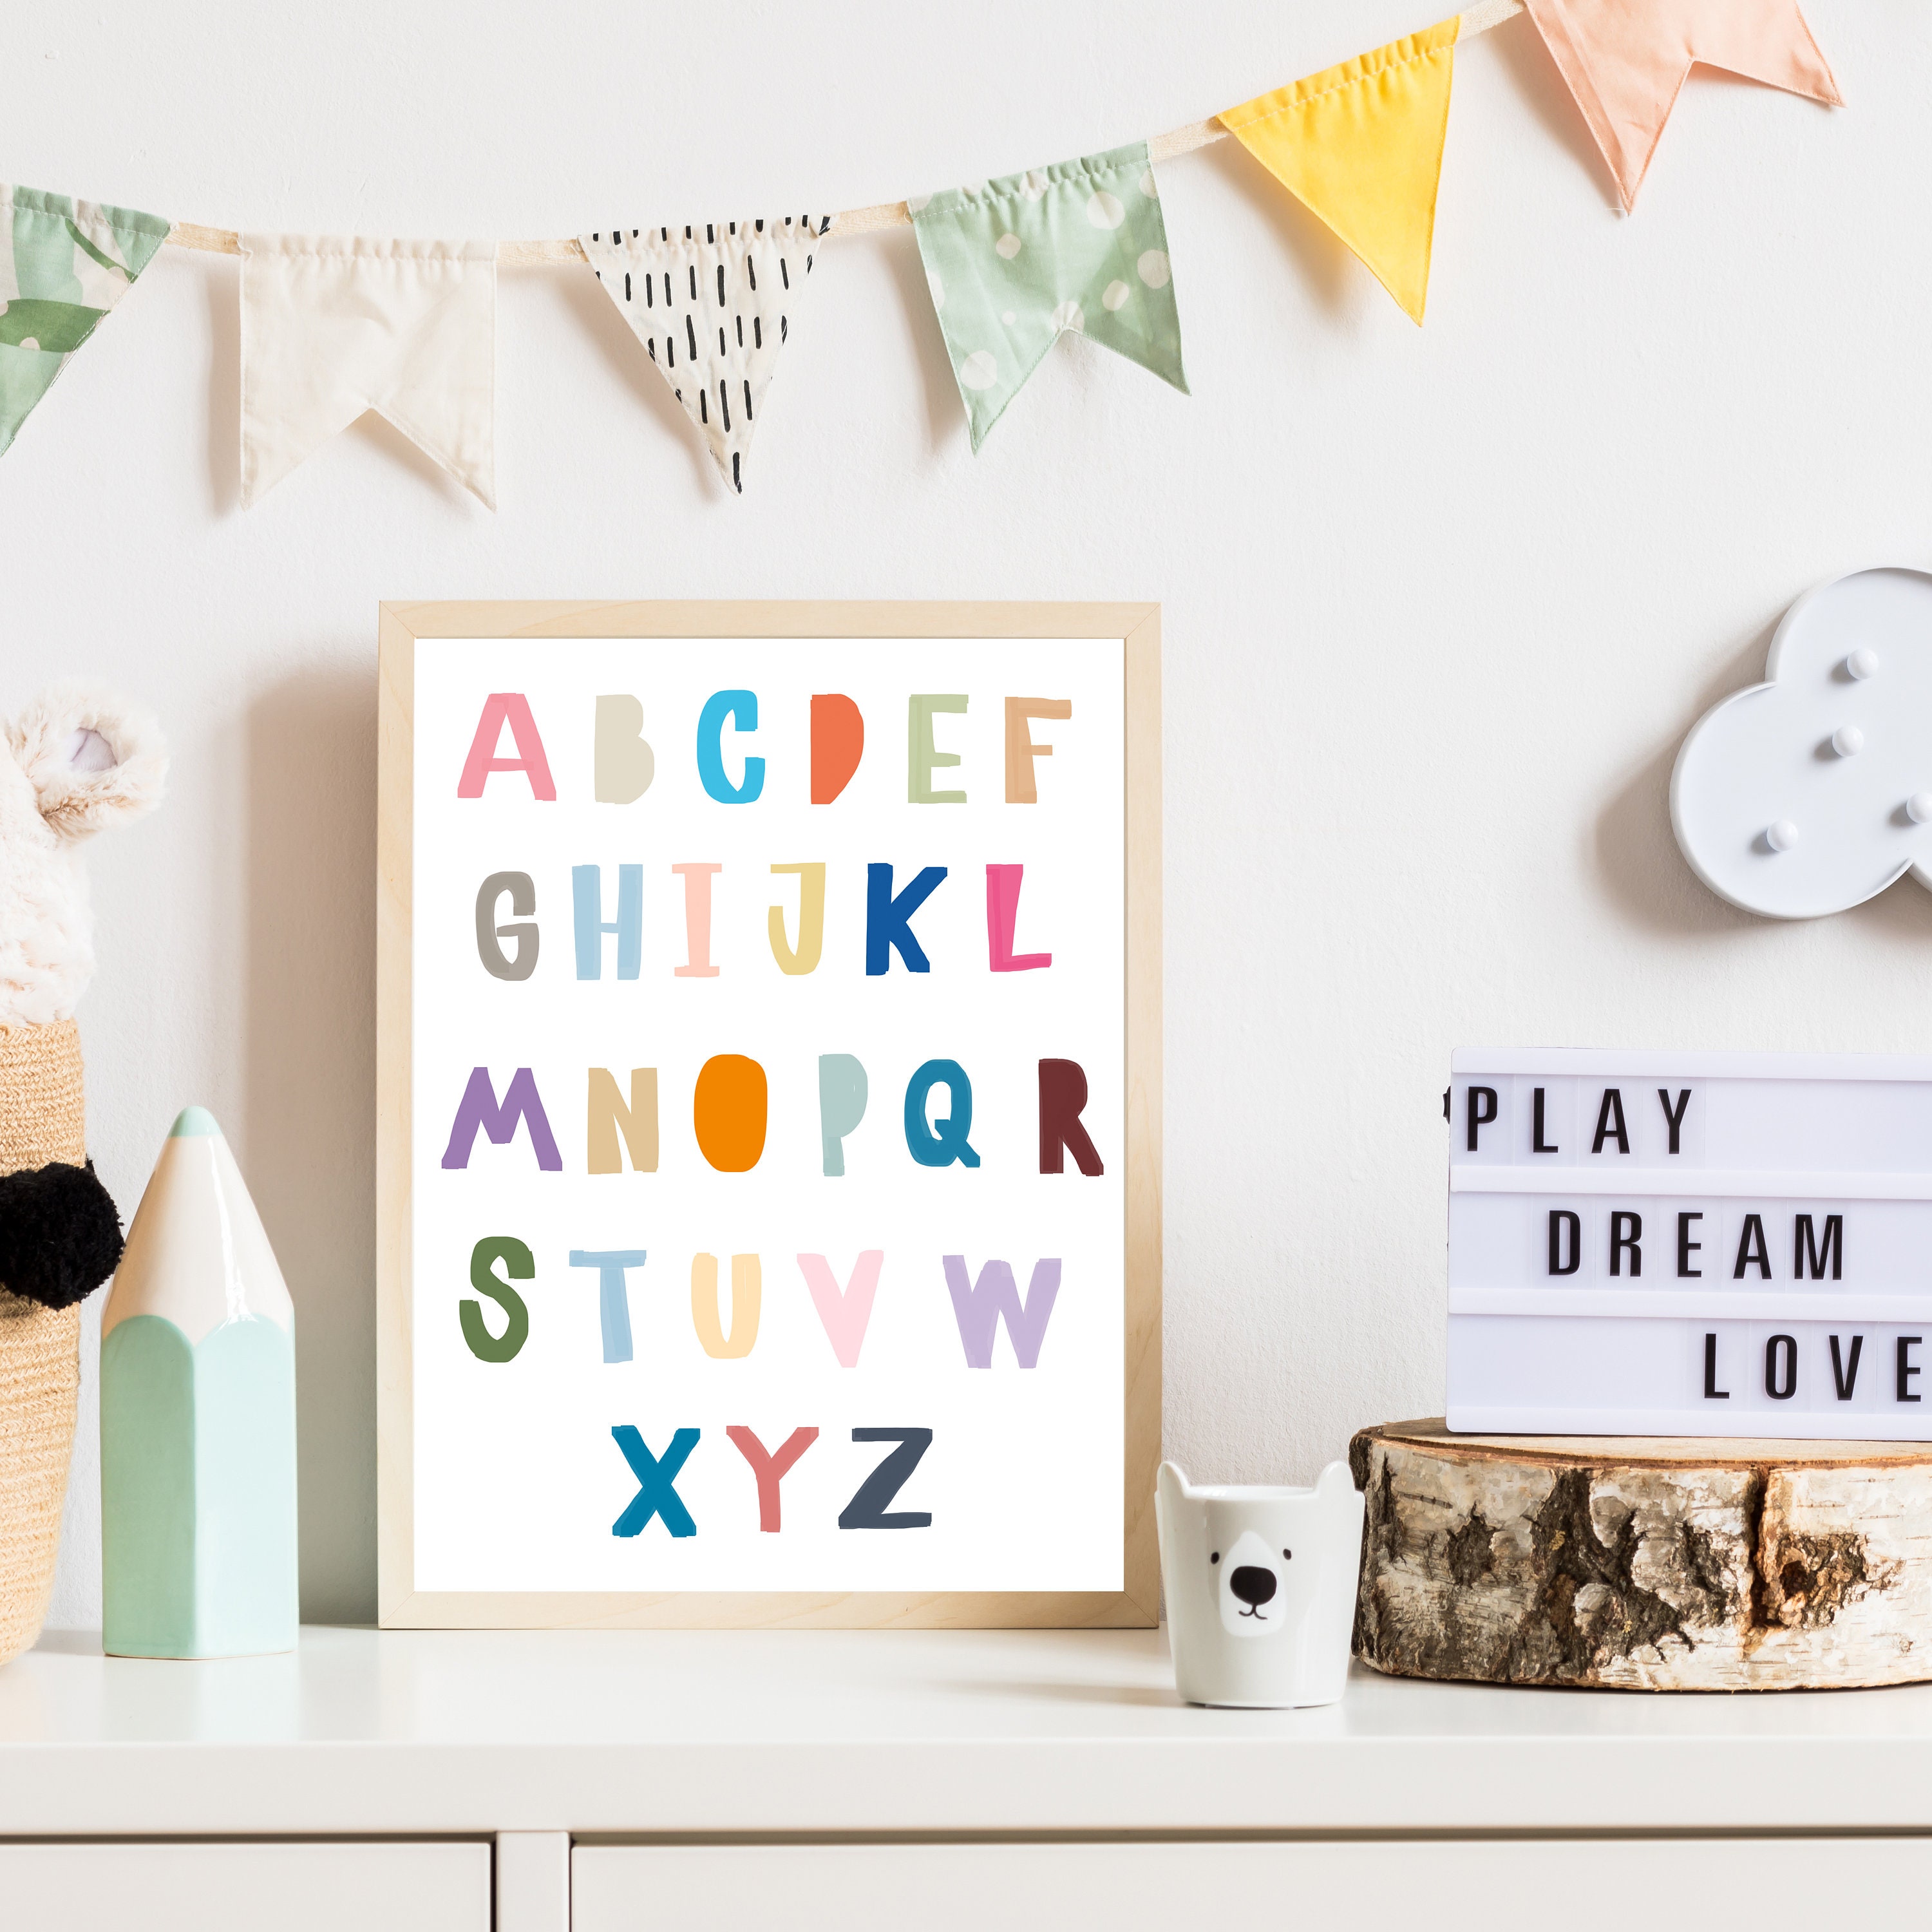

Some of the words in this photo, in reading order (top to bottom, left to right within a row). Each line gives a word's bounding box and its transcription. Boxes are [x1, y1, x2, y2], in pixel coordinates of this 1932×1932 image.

[1467, 1086, 1692, 1155] PLAY
[1548, 1210, 1843, 1280] DREAM
[1704, 1333, 1922, 1402] LOVE
